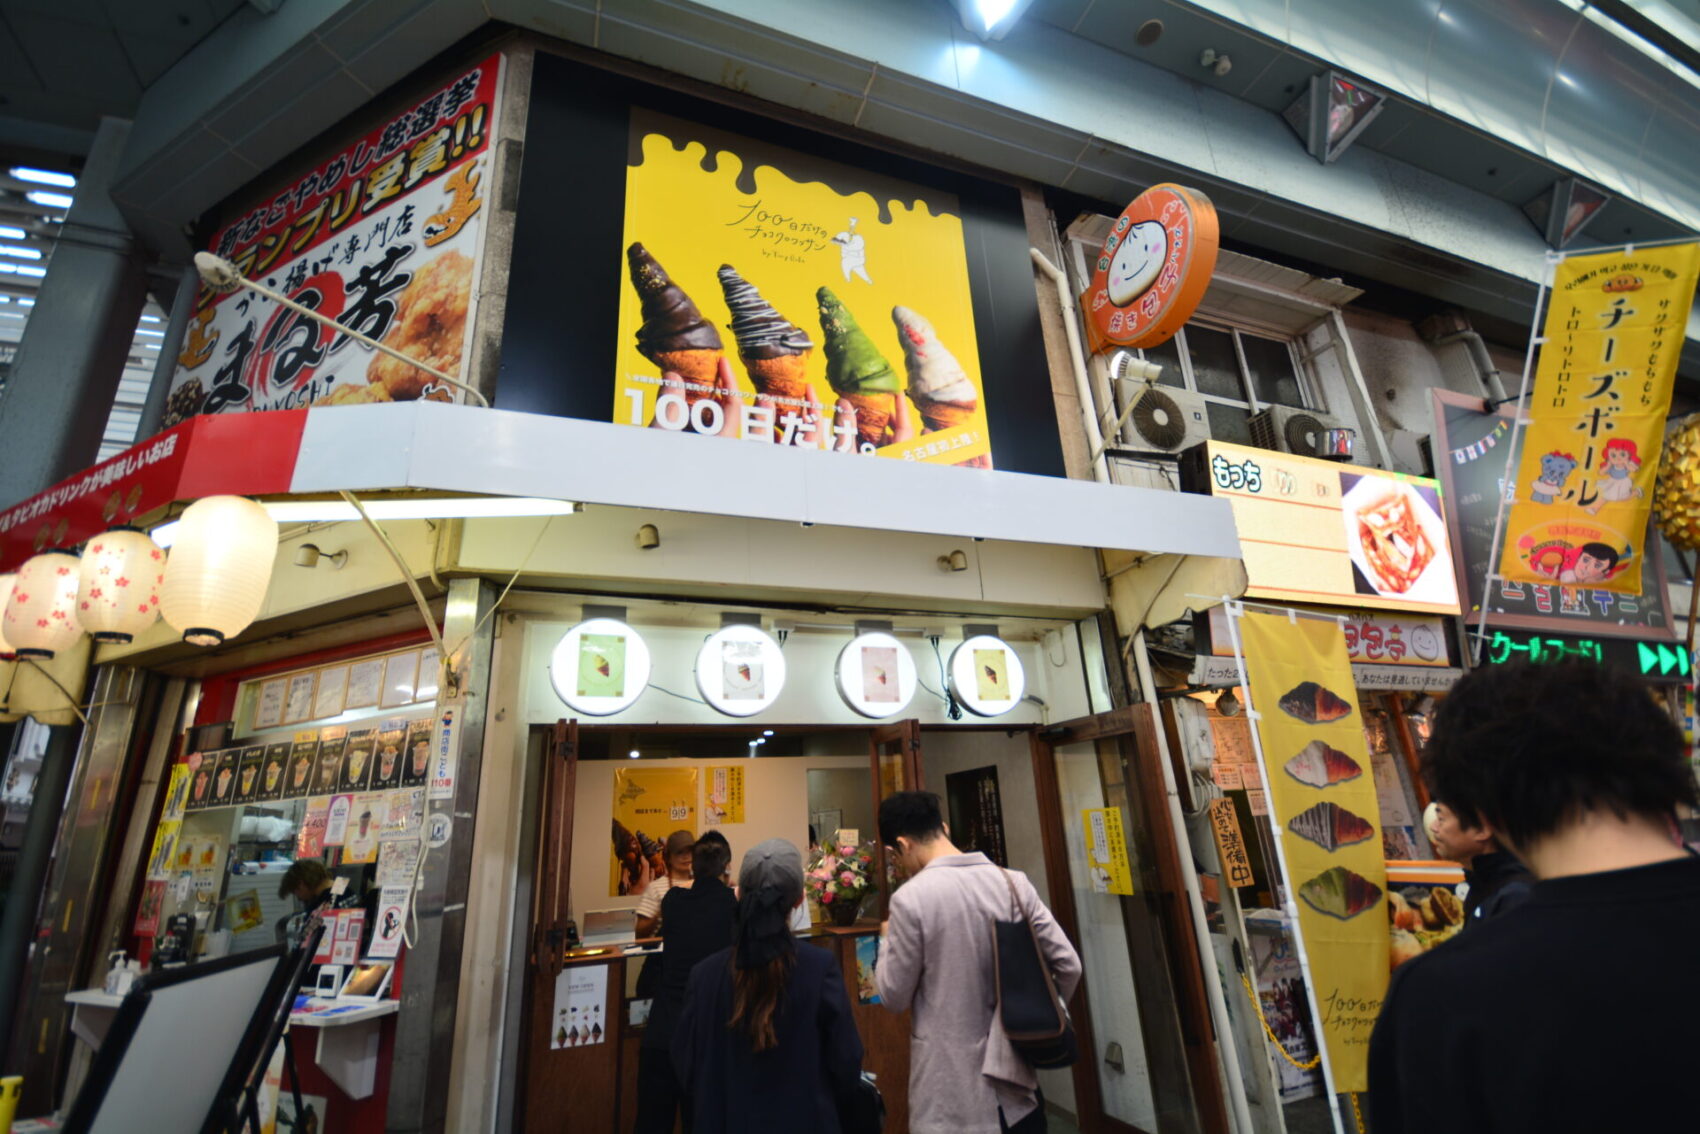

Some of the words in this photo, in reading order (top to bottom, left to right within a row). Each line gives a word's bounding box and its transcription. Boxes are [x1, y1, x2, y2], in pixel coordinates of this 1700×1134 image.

[1565, 298, 1635, 506] チーズボール
